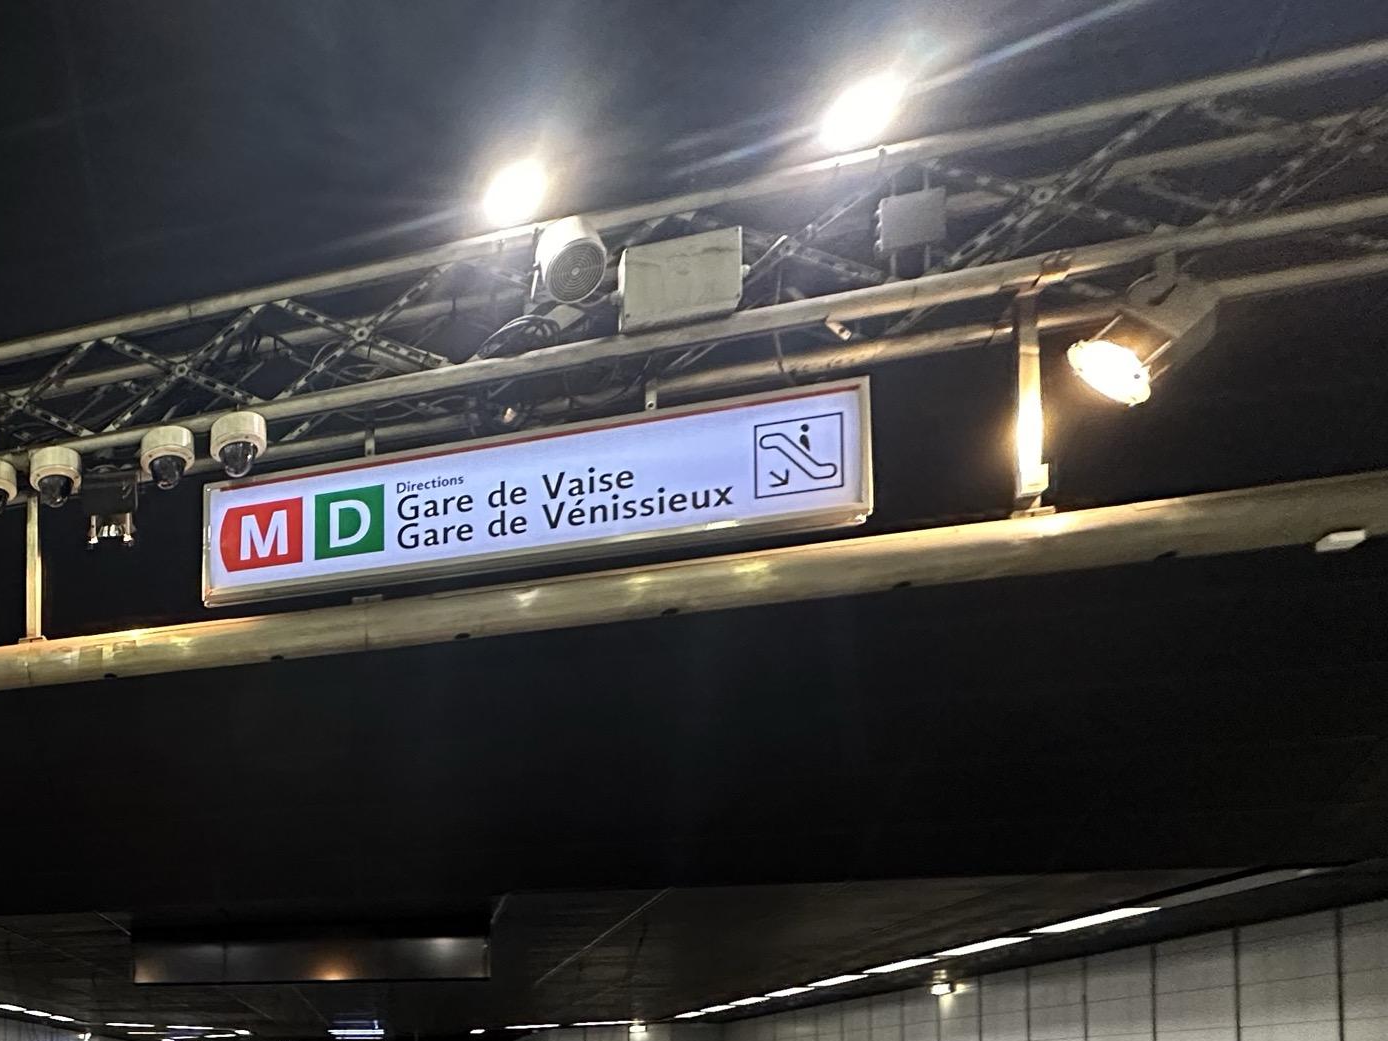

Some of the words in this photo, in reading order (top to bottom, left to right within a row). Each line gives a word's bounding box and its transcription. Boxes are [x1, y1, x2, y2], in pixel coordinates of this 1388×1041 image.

[397, 475, 464, 494] Directions
[397, 494, 474, 521] Gare
[488, 481, 527, 508] de
[542, 467, 635, 499] Vaise
[240, 509, 289, 561] M
[329, 499, 371, 549] D
[397, 522, 474, 549] Gare
[488, 510, 527, 537] de
[542, 486, 734, 529] Vénissieux
